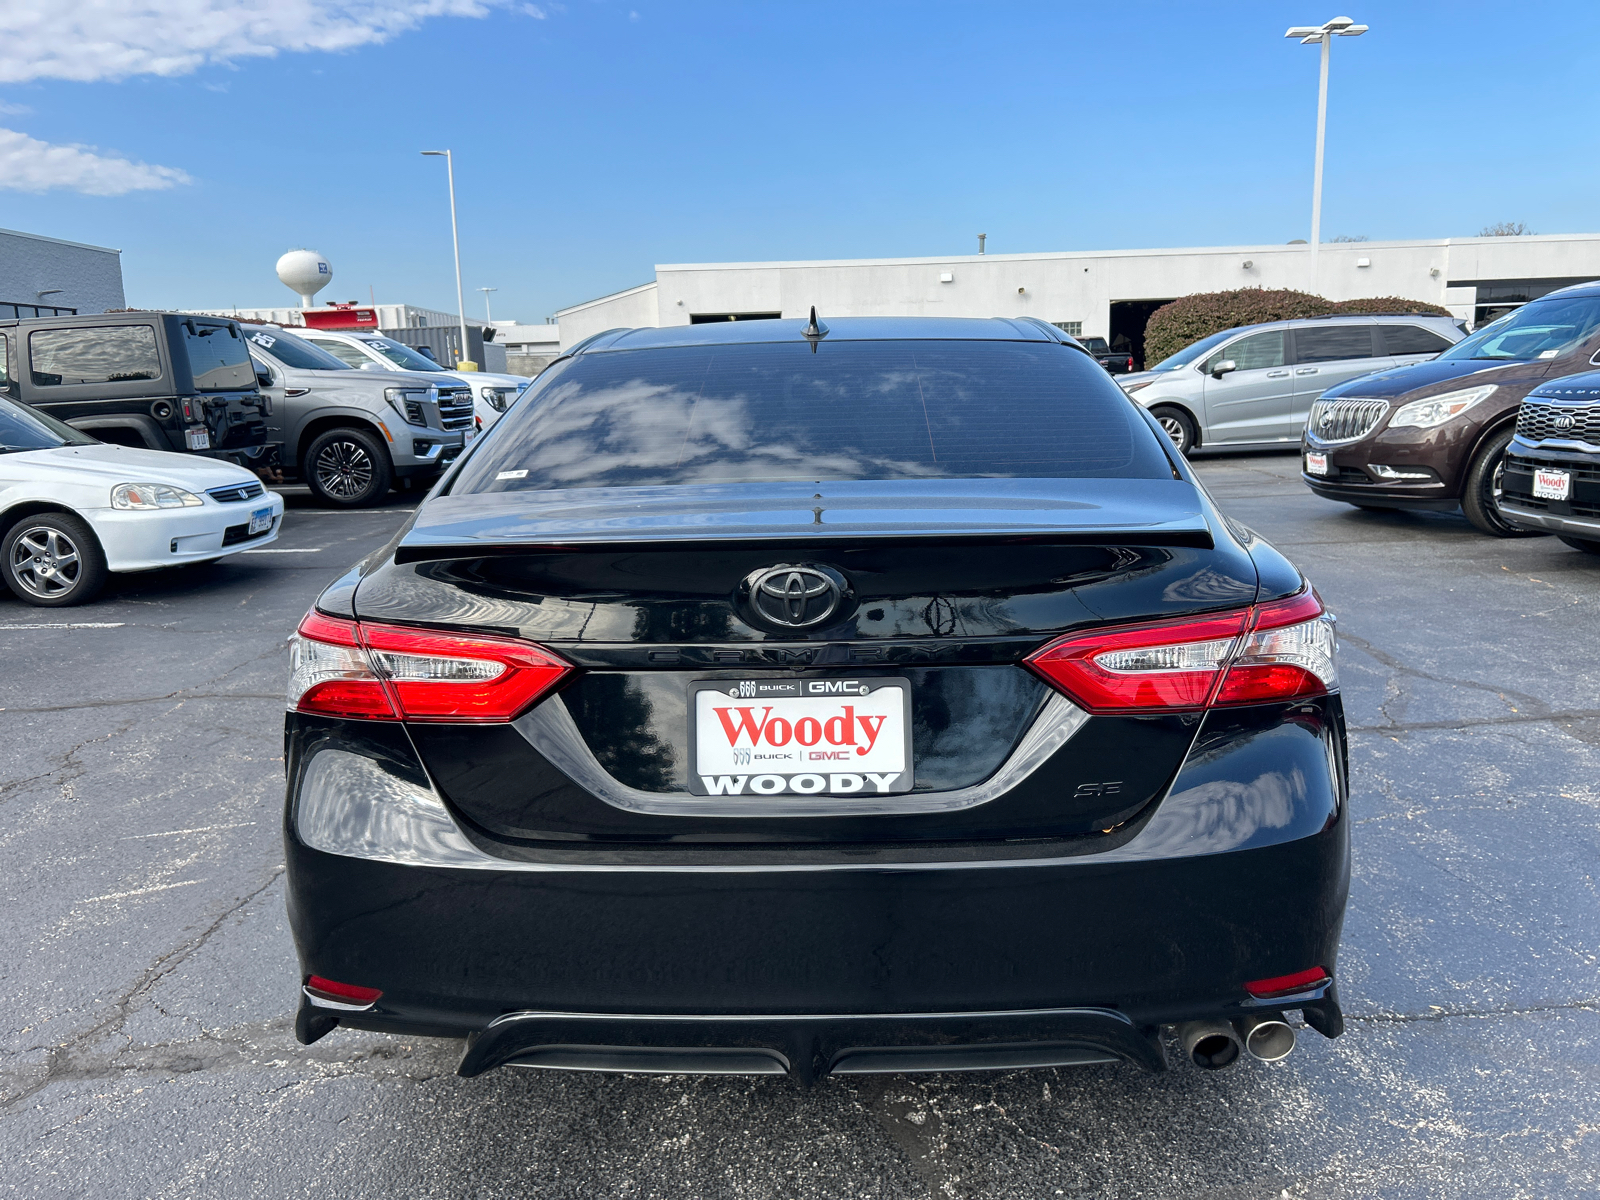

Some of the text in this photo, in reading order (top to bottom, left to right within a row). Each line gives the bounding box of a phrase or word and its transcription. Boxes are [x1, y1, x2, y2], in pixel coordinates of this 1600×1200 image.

[1555, 417, 1570, 428] KIA
[1538, 474, 1567, 491] Woody
[1533, 491, 1568, 501] WOODY
[759, 680, 859, 693] BUICK GMC
[712, 705, 887, 756] Woody
[808, 751, 850, 761] GMC
[701, 773, 901, 796] WOODY
[1073, 780, 1124, 798] SE
